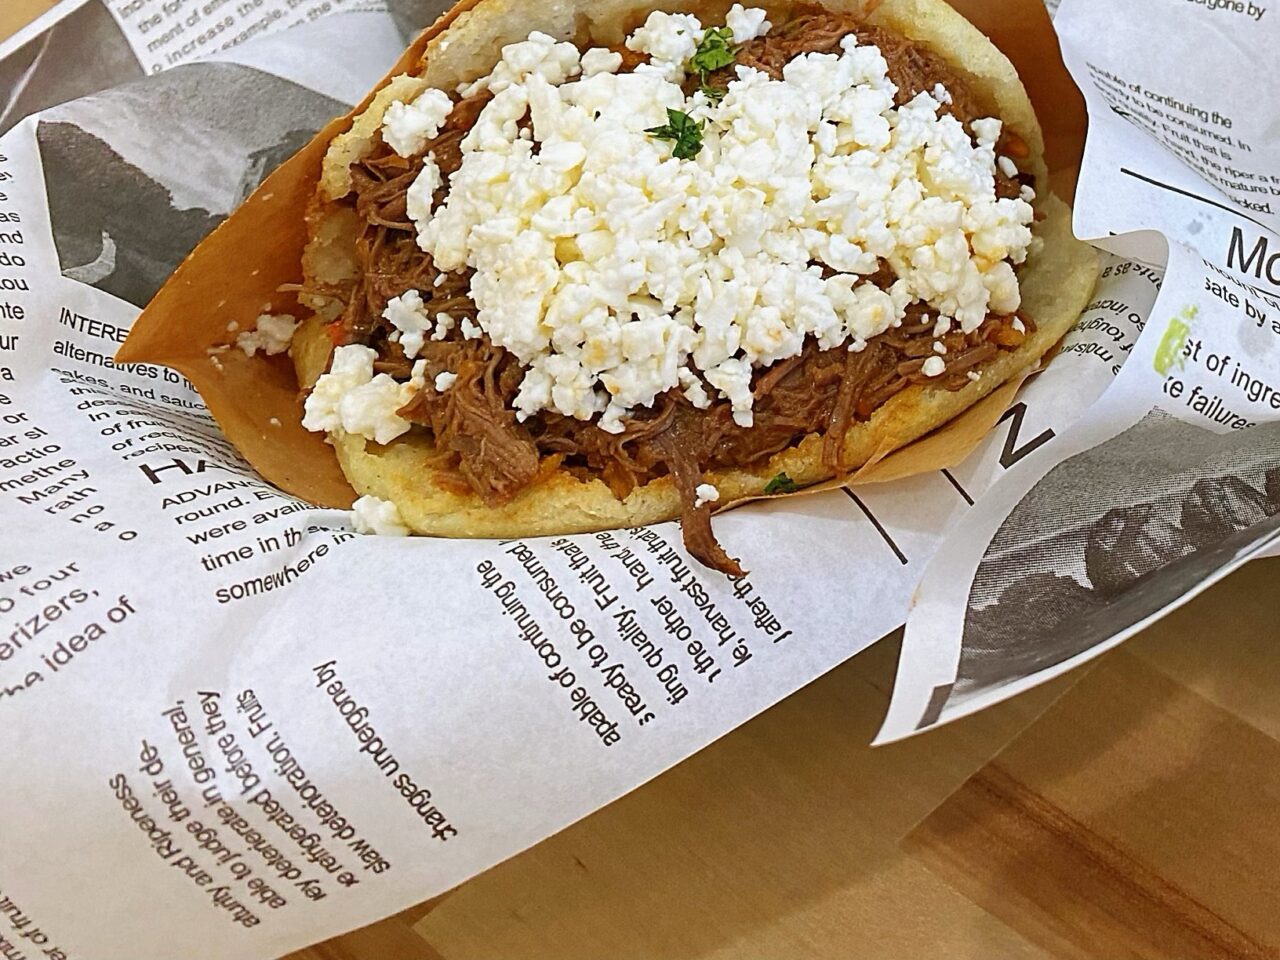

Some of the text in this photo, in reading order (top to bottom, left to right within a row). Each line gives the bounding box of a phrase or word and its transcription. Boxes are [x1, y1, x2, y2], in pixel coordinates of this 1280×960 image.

[1247, 1, 1267, 22] by
[166, 14, 235, 66] increase
[1144, 89, 1209, 124] continuing
[1211, 111, 1233, 129] the
[1245, 298, 1267, 328] by
[163, 367, 180, 384] to
[1206, 352, 1230, 377] of
[120, 383, 156, 400] and
[101, 423, 123, 436] of
[17, 469, 90, 505] Many
[70, 505, 105, 524] no
[174, 496, 250, 525] round.
[118, 530, 138, 541] o
[186, 520, 247, 545] were
[201, 537, 281, 572] time in
[216, 533, 355, 604] somewhere in
[610, 546, 654, 592] hand,
[657, 547, 690, 583] fruit
[20, 561, 80, 597] four
[578, 564, 618, 610] Fruit
[506, 542, 647, 717] ready to be consumed.
[650, 595, 692, 641] other
[680, 576, 736, 647] harvest
[745, 596, 782, 636] after
[41, 594, 136, 672] idea of
[476, 559, 621, 746] apable of continuing the
[613, 605, 663, 668] quality.
[313, 660, 338, 688] by
[687, 640, 714, 674] the
[656, 663, 689, 706] ting
[236, 689, 273, 738] Fruits
[327, 680, 401, 778] undergone
[161, 700, 216, 785] general,
[197, 690, 343, 874] refrigerated before they
[265, 731, 355, 841] deterioration.
[109, 773, 181, 860] Ripeness
[139, 739, 287, 909] able to judge their de-
[173, 856, 213, 887] and
